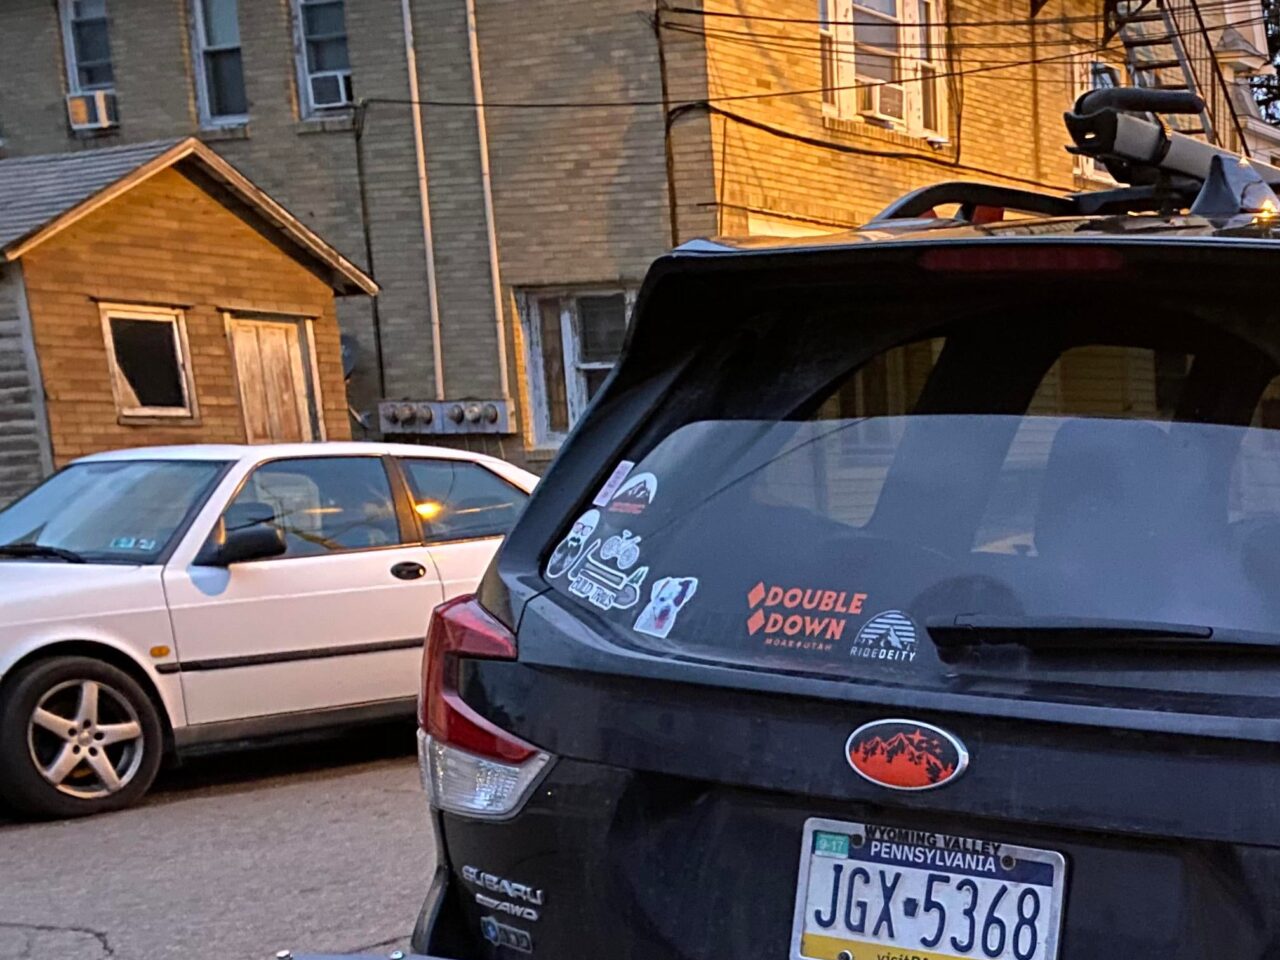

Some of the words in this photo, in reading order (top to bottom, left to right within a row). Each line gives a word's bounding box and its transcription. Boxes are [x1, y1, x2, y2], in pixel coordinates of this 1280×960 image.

[764, 585, 868, 615] DOUBLE
[764, 612, 846, 641] DOWN
[864, 825, 937, 845] WYOMING
[942, 836, 1002, 855] VALLEY
[870, 841, 996, 873] PENNSYLVANIA
[461, 864, 542, 906] SUBARU
